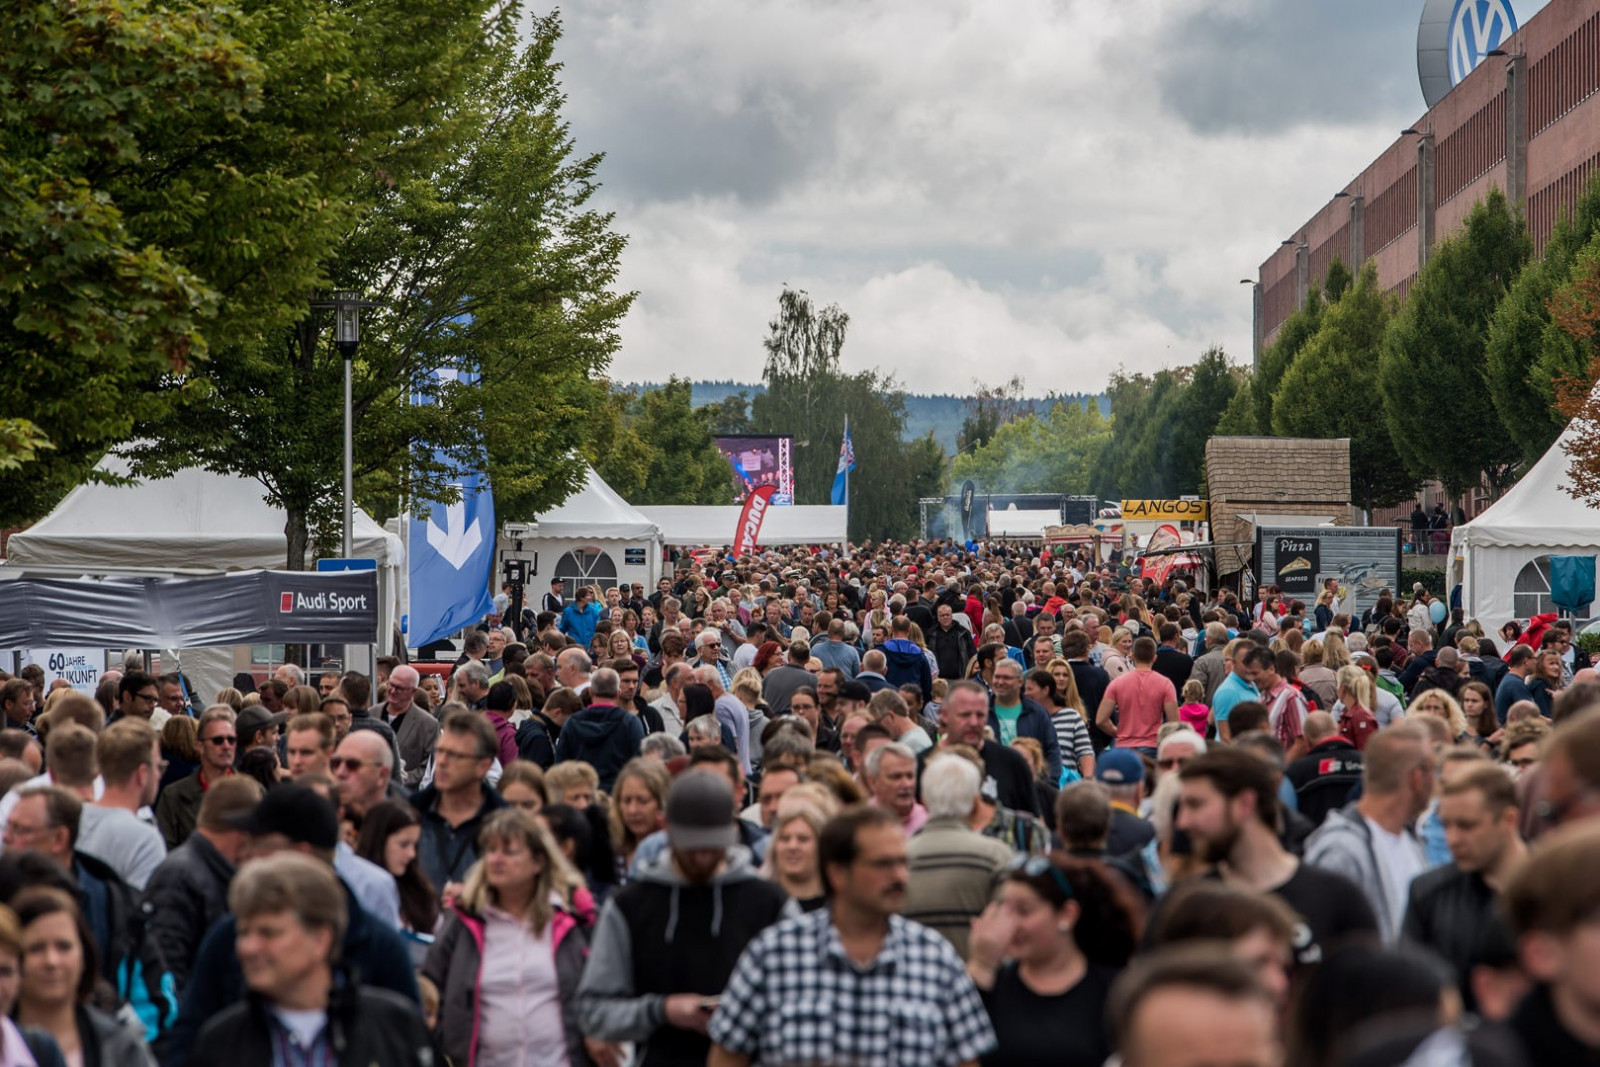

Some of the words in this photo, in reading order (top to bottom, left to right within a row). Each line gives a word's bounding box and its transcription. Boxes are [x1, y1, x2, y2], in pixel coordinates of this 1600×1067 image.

[1123, 500, 1203, 515] LANGOS
[1280, 539, 1313, 552] Pizza
[296, 592, 326, 609] Audi
[329, 592, 367, 613] Sport
[49, 653, 65, 671] 60
[65, 656, 86, 666] JAHRE
